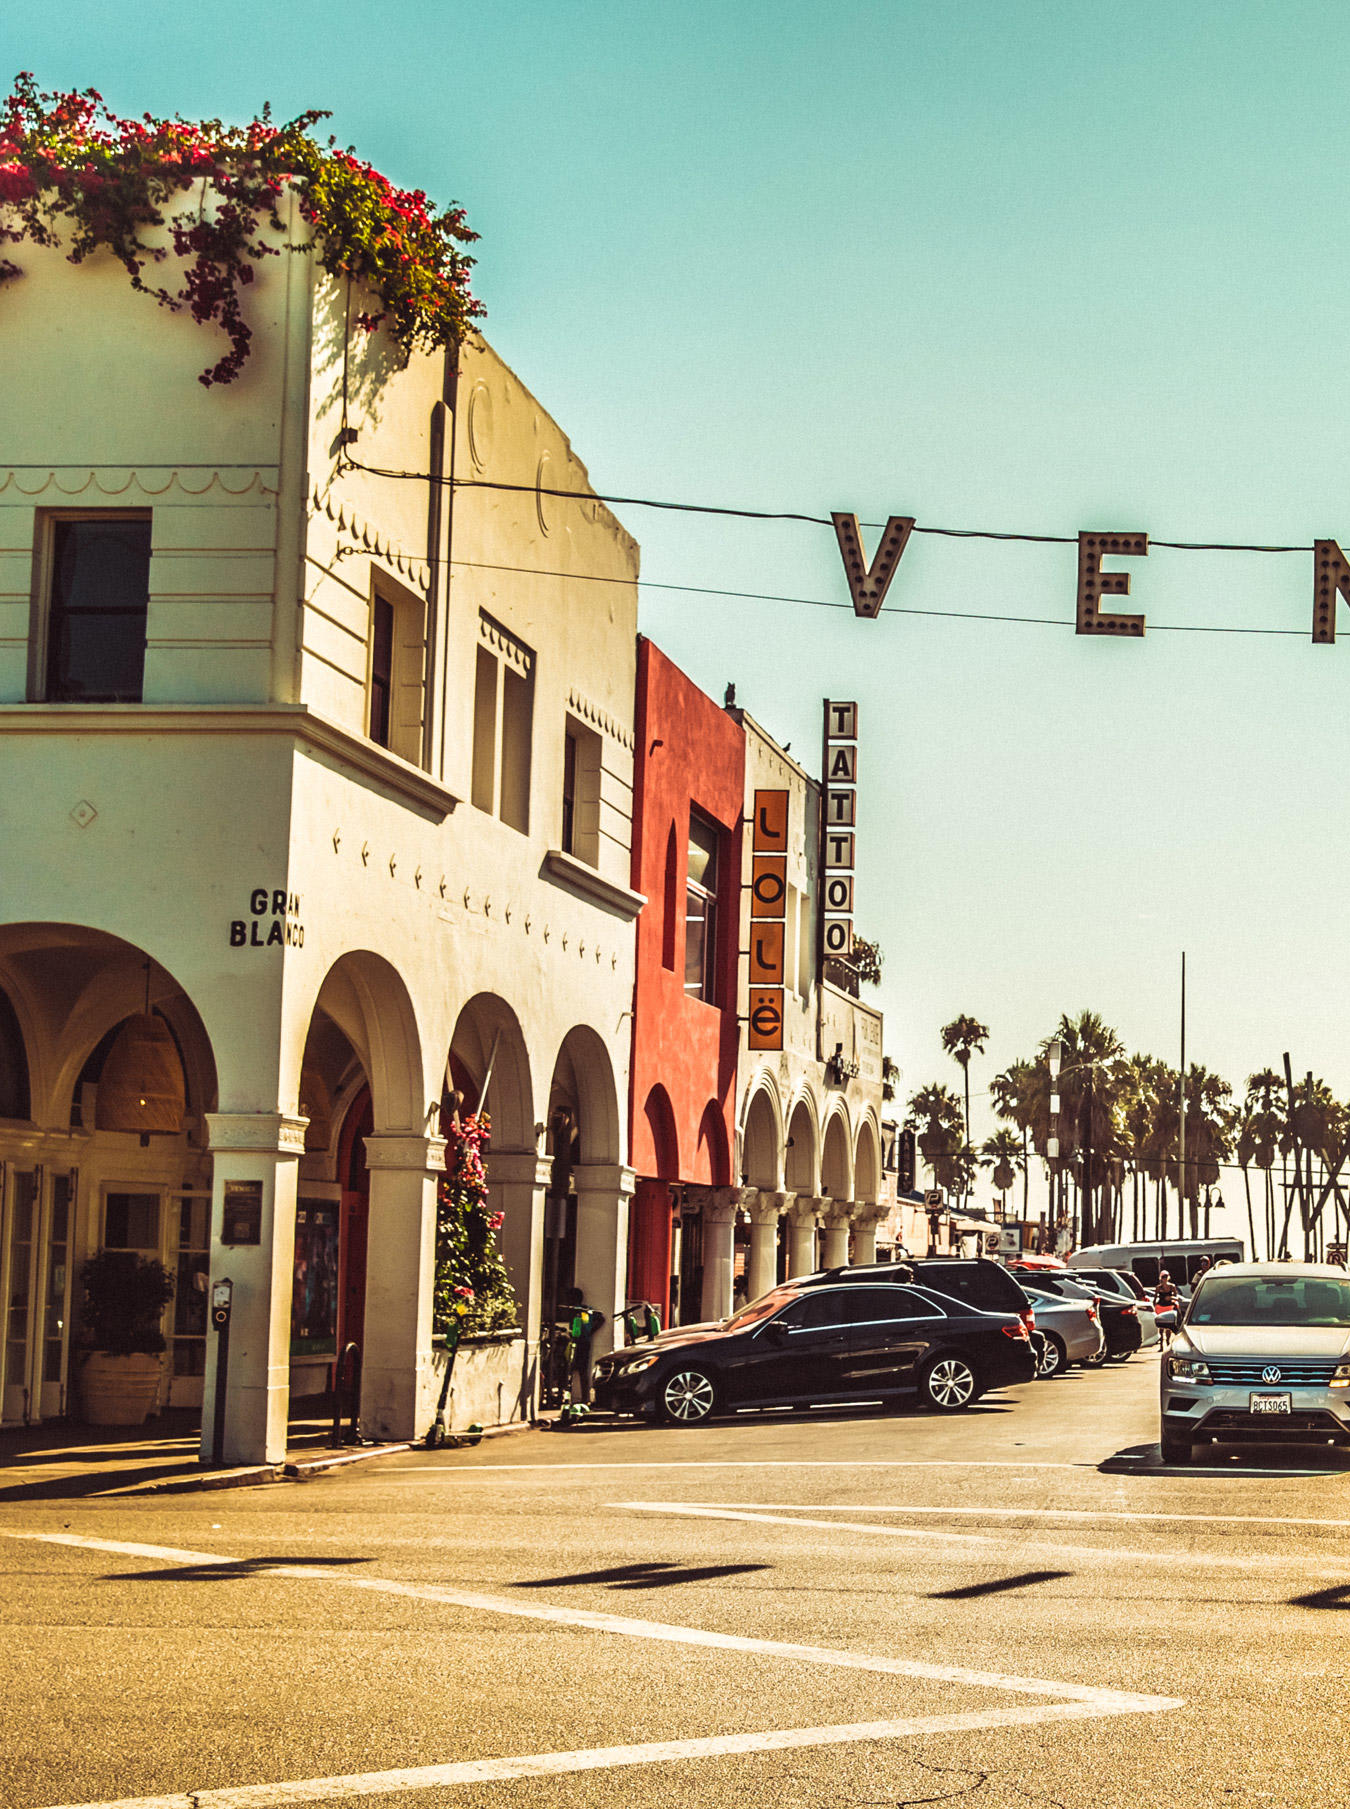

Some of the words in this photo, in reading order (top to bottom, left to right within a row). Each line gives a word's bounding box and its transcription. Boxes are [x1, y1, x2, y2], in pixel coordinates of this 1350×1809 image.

[827, 706, 851, 948] TATTOO
[250, 888, 300, 917] GRAN
[230, 920, 305, 948] BLANCO
